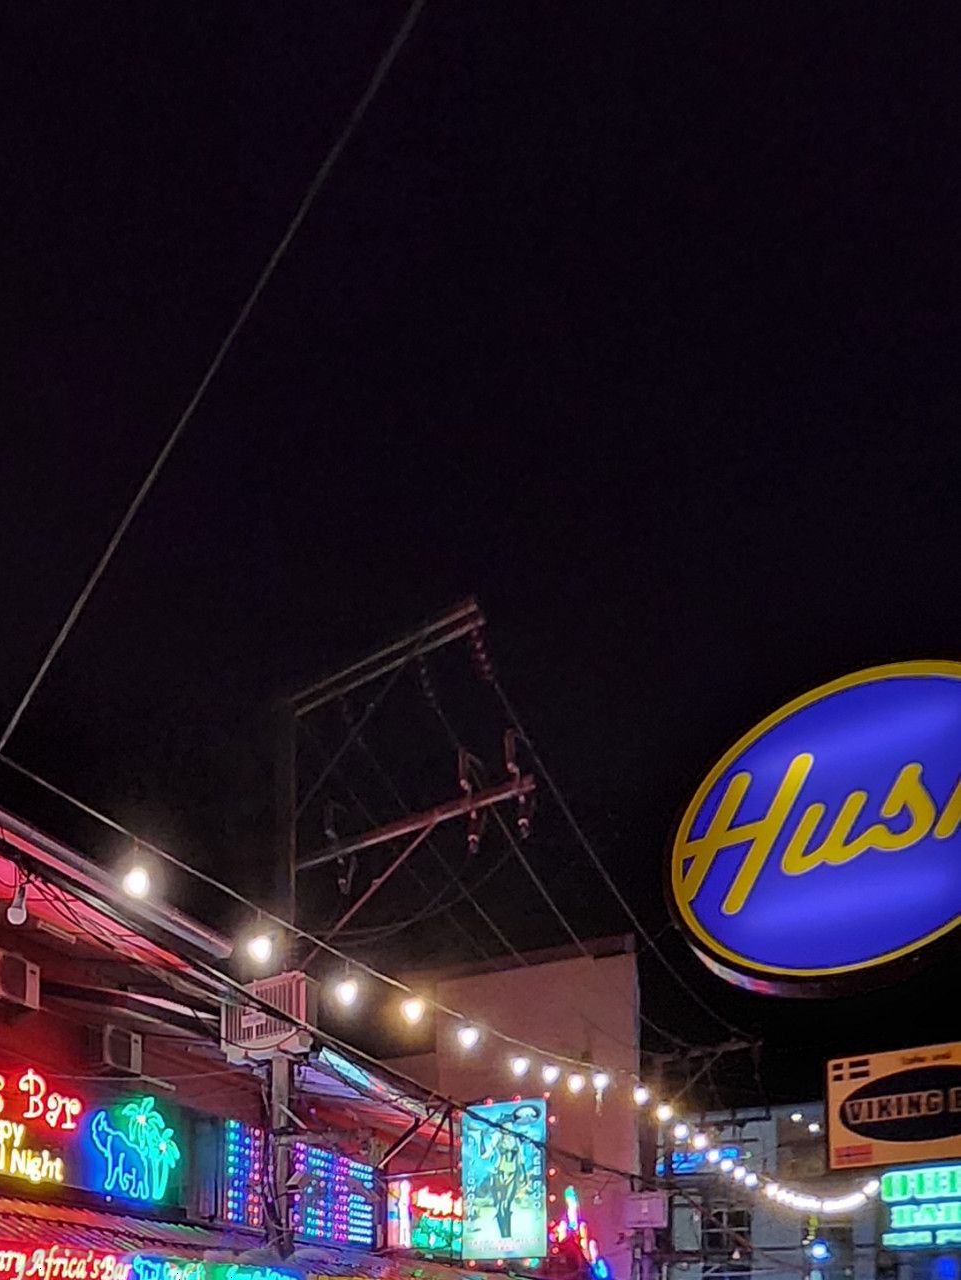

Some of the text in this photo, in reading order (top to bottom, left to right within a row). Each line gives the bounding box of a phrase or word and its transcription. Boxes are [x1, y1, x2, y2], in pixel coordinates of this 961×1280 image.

[18, 1068, 81, 1129] Bar
[845, 1089, 944, 1124] VIKING
[10, 1148, 63, 1184] Night
